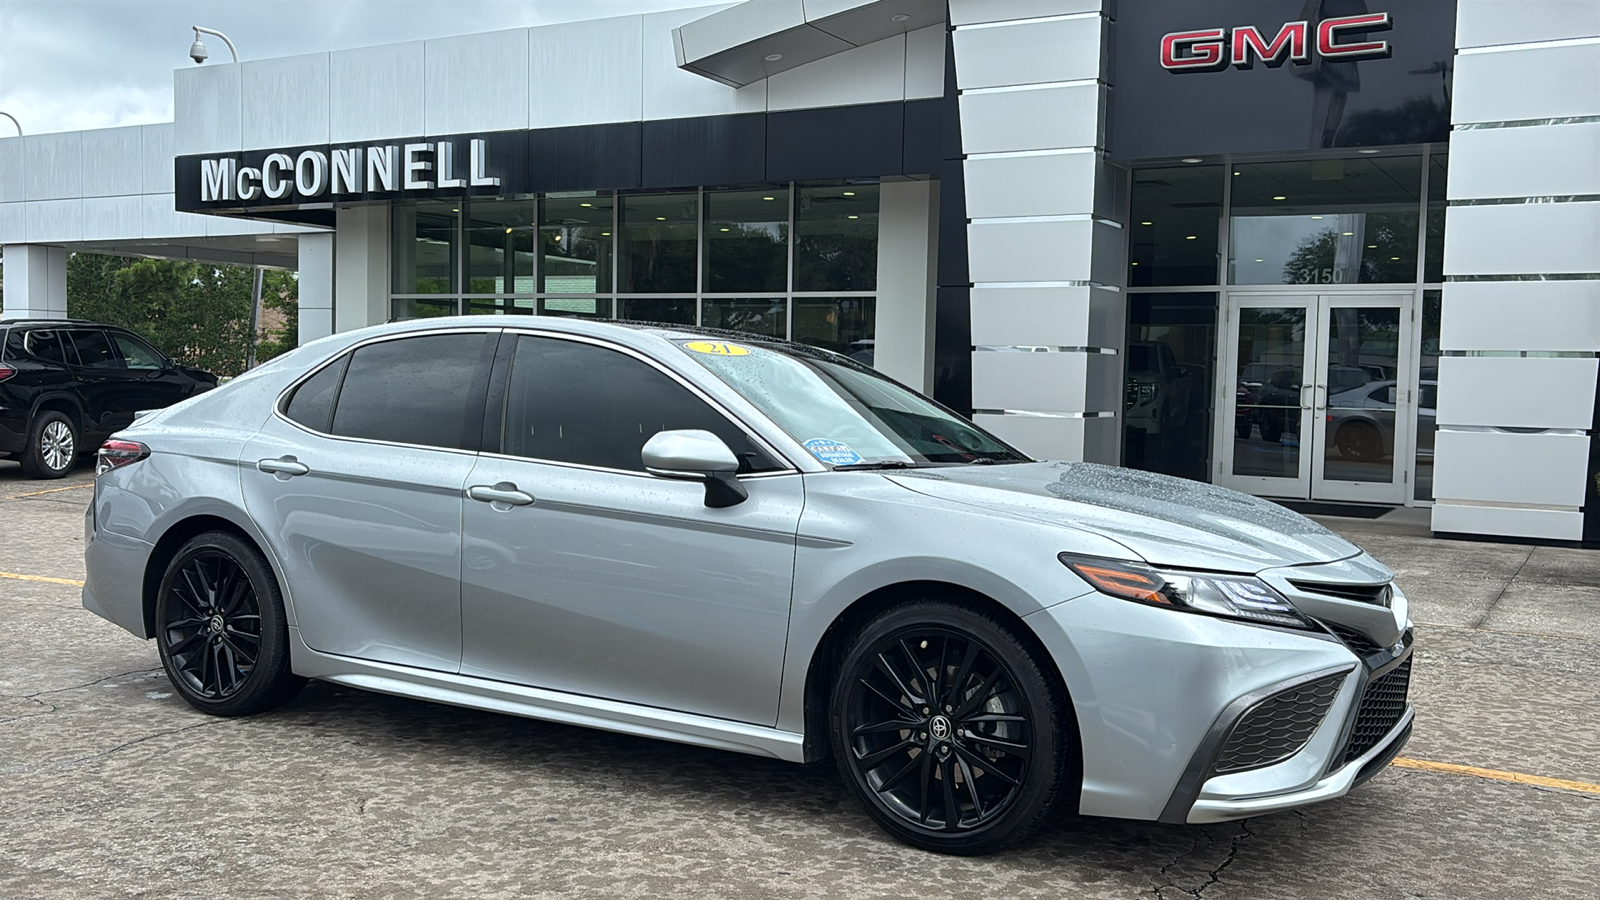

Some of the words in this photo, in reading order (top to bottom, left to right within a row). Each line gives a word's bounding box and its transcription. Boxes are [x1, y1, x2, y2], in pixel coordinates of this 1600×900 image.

[1160, 12, 1391, 70] GMC
[201, 139, 500, 202] McCONNELL
[1299, 268, 1343, 284] 3150
[705, 342, 731, 354] 21
